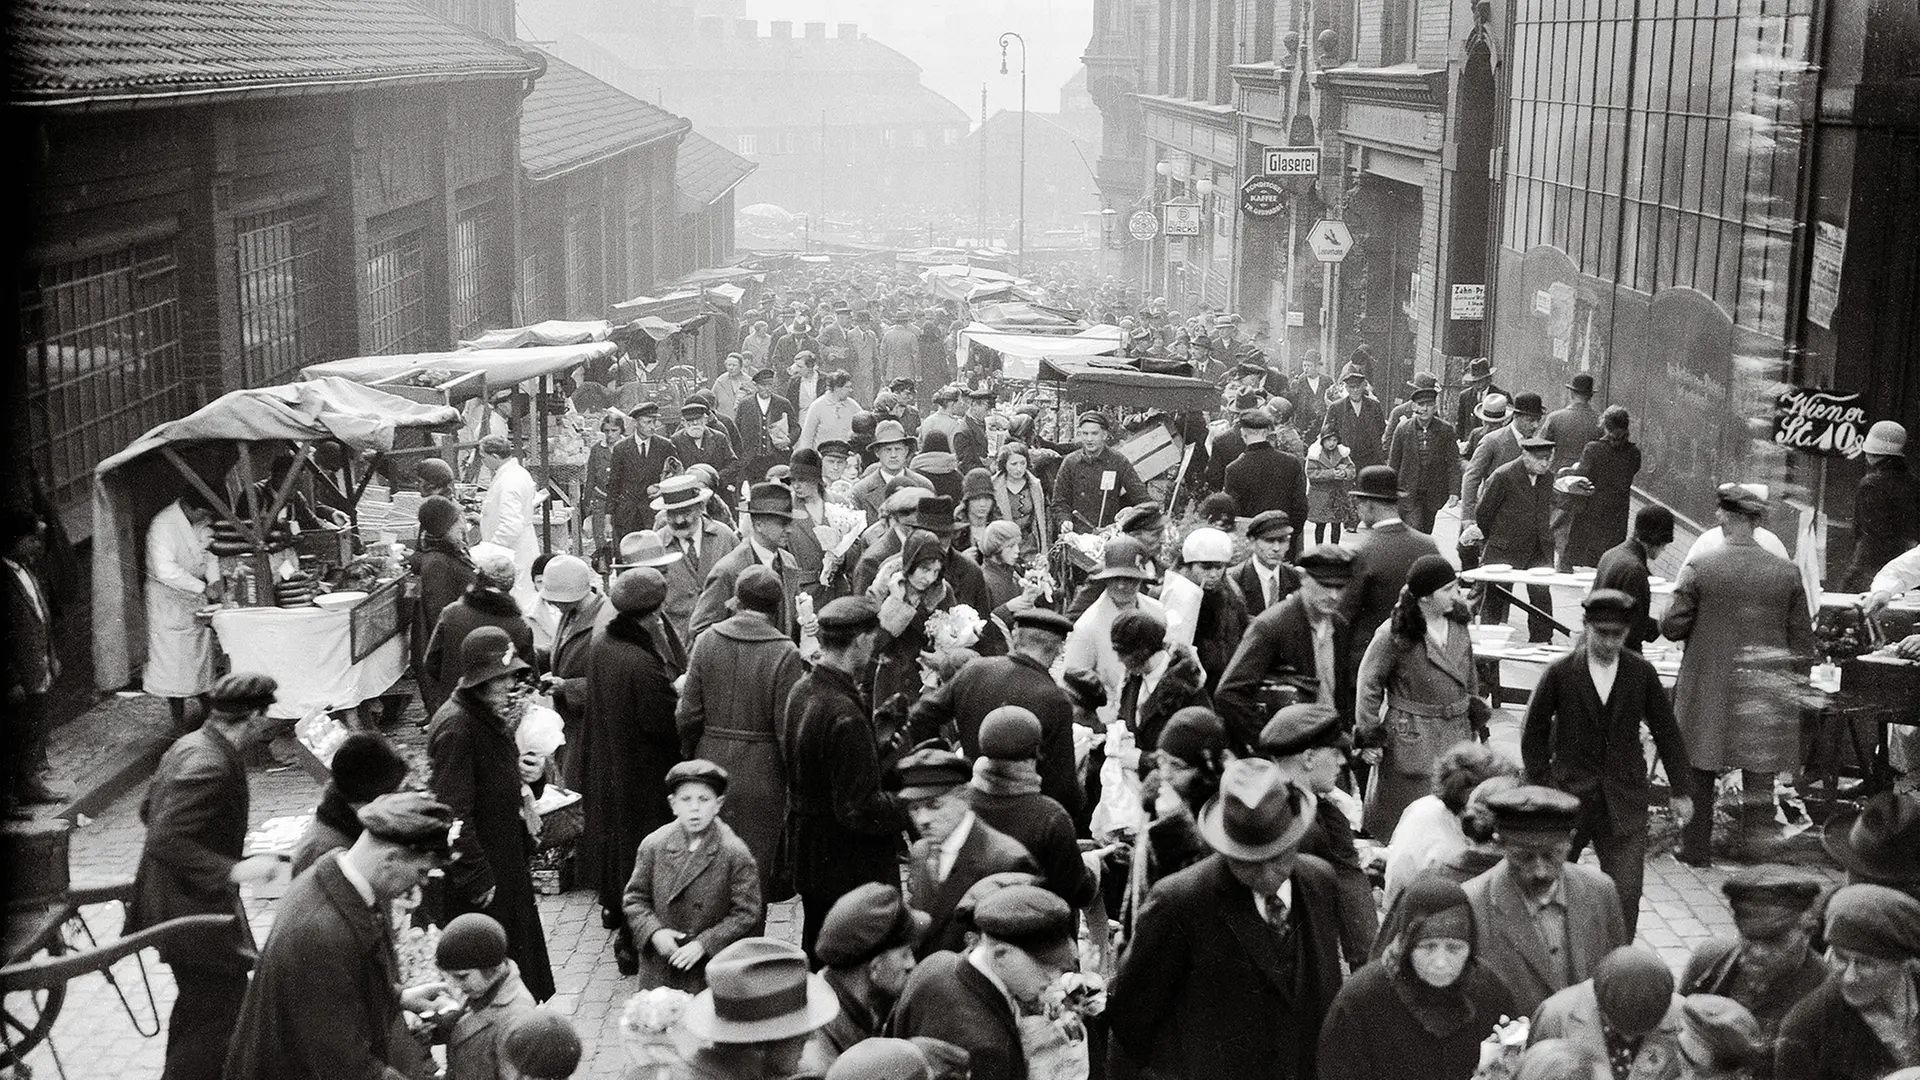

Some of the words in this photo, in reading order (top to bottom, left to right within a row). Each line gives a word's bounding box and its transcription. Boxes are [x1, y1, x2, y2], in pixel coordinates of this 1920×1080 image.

[1269, 153, 1315, 172] Glaserei
[1244, 181, 1283, 194] KONDITOREI
[1780, 392, 1867, 424] Wiener
